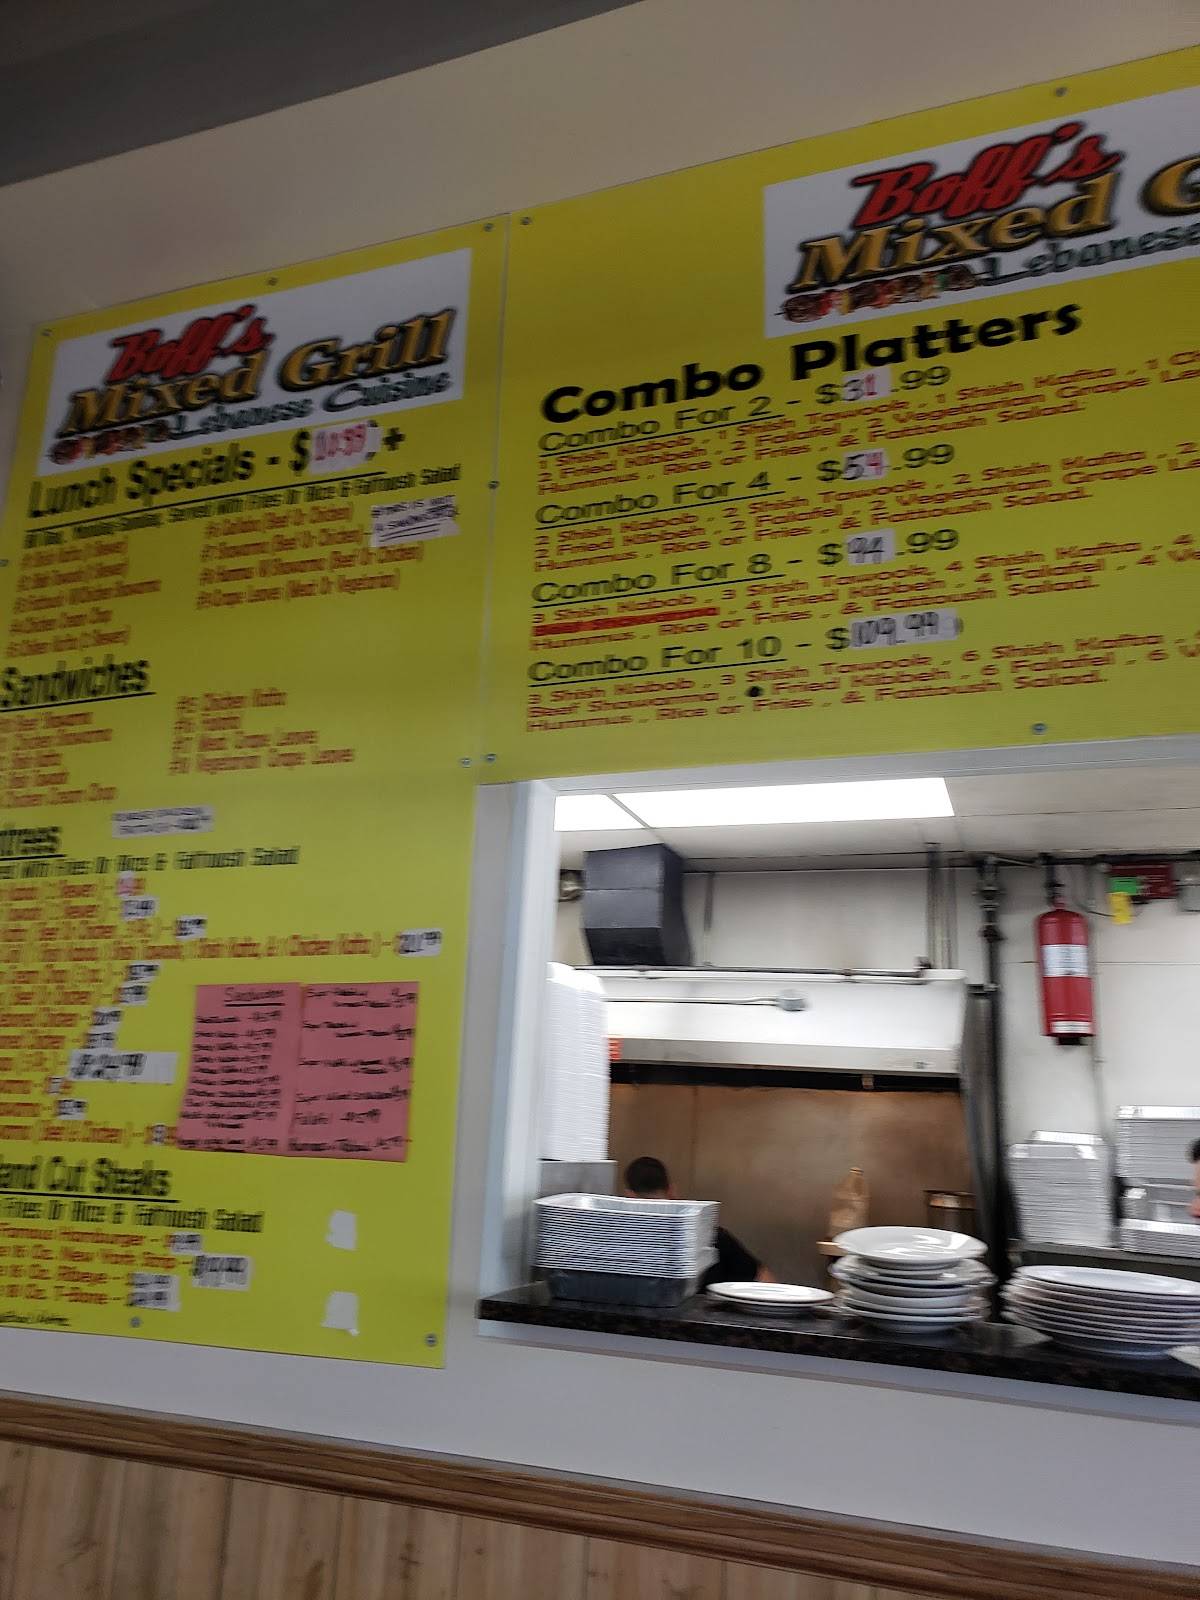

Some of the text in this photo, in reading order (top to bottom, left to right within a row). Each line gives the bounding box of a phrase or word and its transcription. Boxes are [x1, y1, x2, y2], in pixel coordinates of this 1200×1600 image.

[851, 120, 1125, 229] Boff's
[786, 171, 1121, 293] Mixed
[55, 308, 457, 438] Mixed Grill
[541, 304, 1082, 423] Combo Platters
[538, 420, 660, 451] Combo
[675, 406, 735, 432] For
[748, 396, 771, 415] 2
[560, 462, 616, 479] Fried
[893, 394, 1045, 422] Vegetarian
[1057, 377, 1150, 398] Grape
[29, 467, 118, 518] Lunch
[126, 443, 256, 507] Specials
[663, 461, 711, 477] Rice
[838, 434, 860, 447] &
[535, 494, 658, 524] Combo
[673, 481, 734, 505] For
[746, 471, 770, 491] 4
[556, 538, 614, 555] Fried
[896, 478, 1052, 506] Vegetarian
[1062, 464, 1158, 485] Grape
[662, 540, 710, 555] Rice
[840, 517, 861, 529] &
[532, 573, 656, 603] Combo
[671, 563, 734, 585] For
[747, 553, 772, 574] 8
[771, 592, 839, 608] Fried
[659, 620, 709, 635] Rice
[840, 602, 863, 614] &
[1, 654, 151, 708] Sandwiches
[527, 654, 648, 682] Combo
[662, 645, 722, 668] For
[737, 636, 781, 658] 10
[657, 706, 707, 720] Rice
[841, 690, 865, 703] &
[771, 680, 840, 695] Fried
[92, 1157, 172, 1197] Steaks
